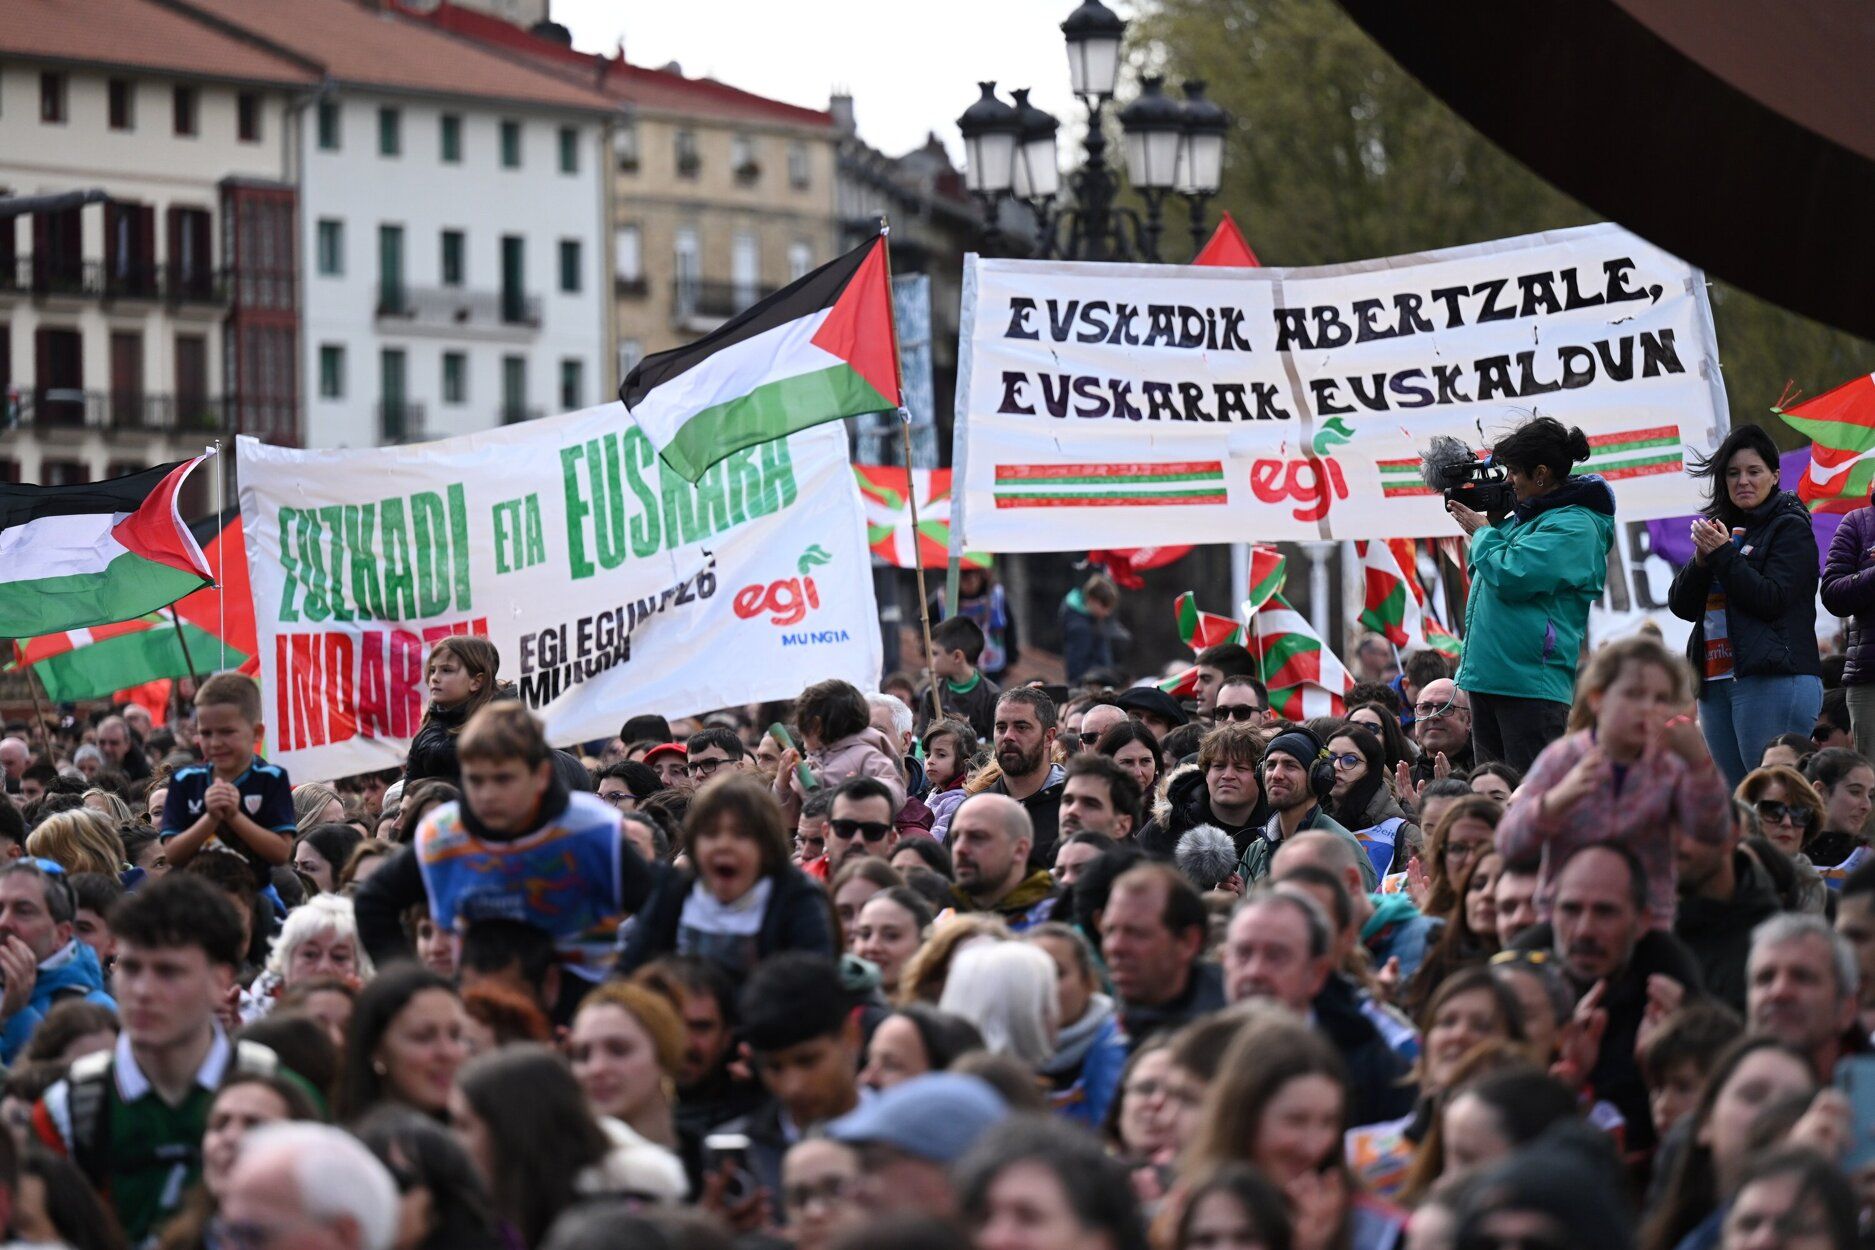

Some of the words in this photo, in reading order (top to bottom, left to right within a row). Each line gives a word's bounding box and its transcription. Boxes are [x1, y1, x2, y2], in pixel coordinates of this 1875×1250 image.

[1273, 256, 1664, 352] ABERTZALE,
[1250, 441, 1349, 522] egi
[491, 492, 546, 575] ETA
[733, 562, 820, 627] egi
[519, 622, 568, 675] EGI
[781, 629, 850, 646] MUNGIA
[275, 616, 490, 752] INDAR
